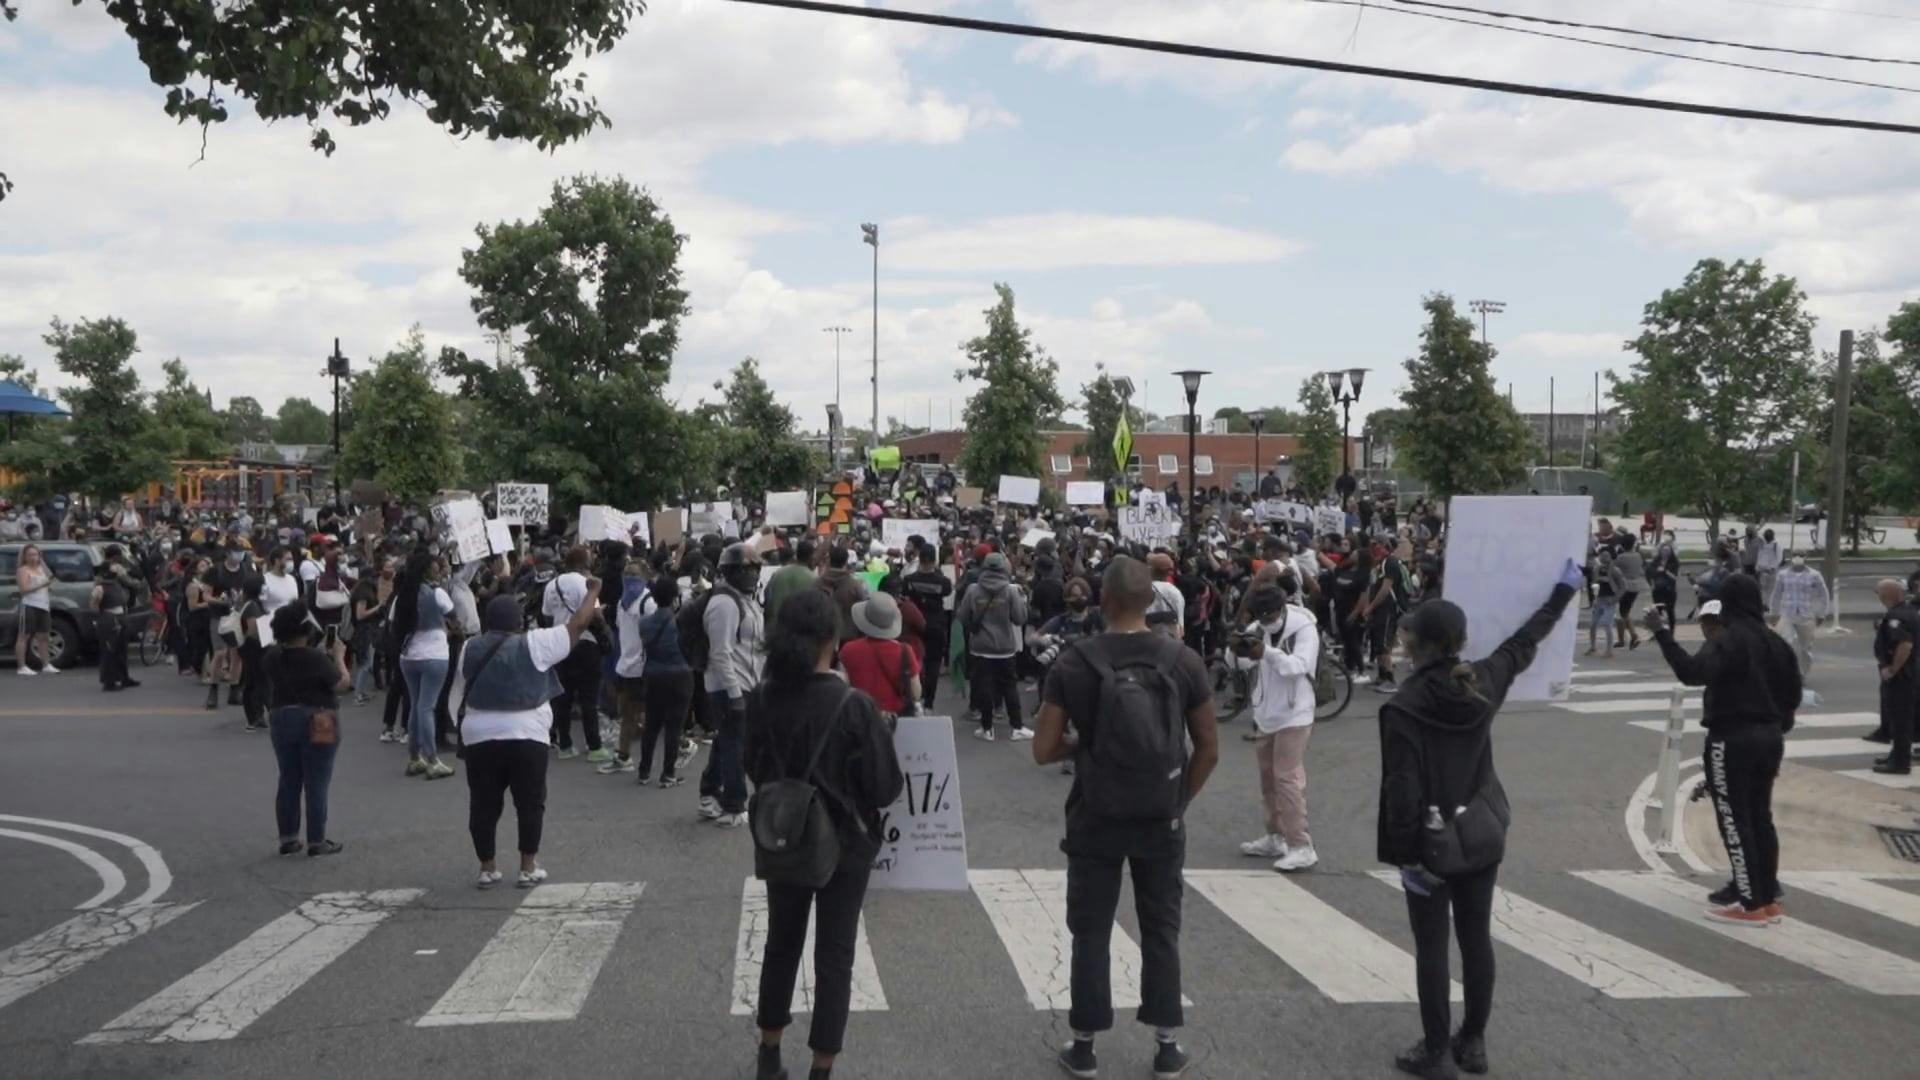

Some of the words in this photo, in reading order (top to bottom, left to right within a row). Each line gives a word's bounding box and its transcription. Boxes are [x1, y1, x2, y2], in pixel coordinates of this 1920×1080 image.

[1126, 506, 1169, 525] BLACK
[1711, 740, 1728, 796] TOMMY
[904, 771, 950, 817] 17%
[1718, 797, 1741, 846] JEANS
[1730, 847, 1753, 900] TOMMY
